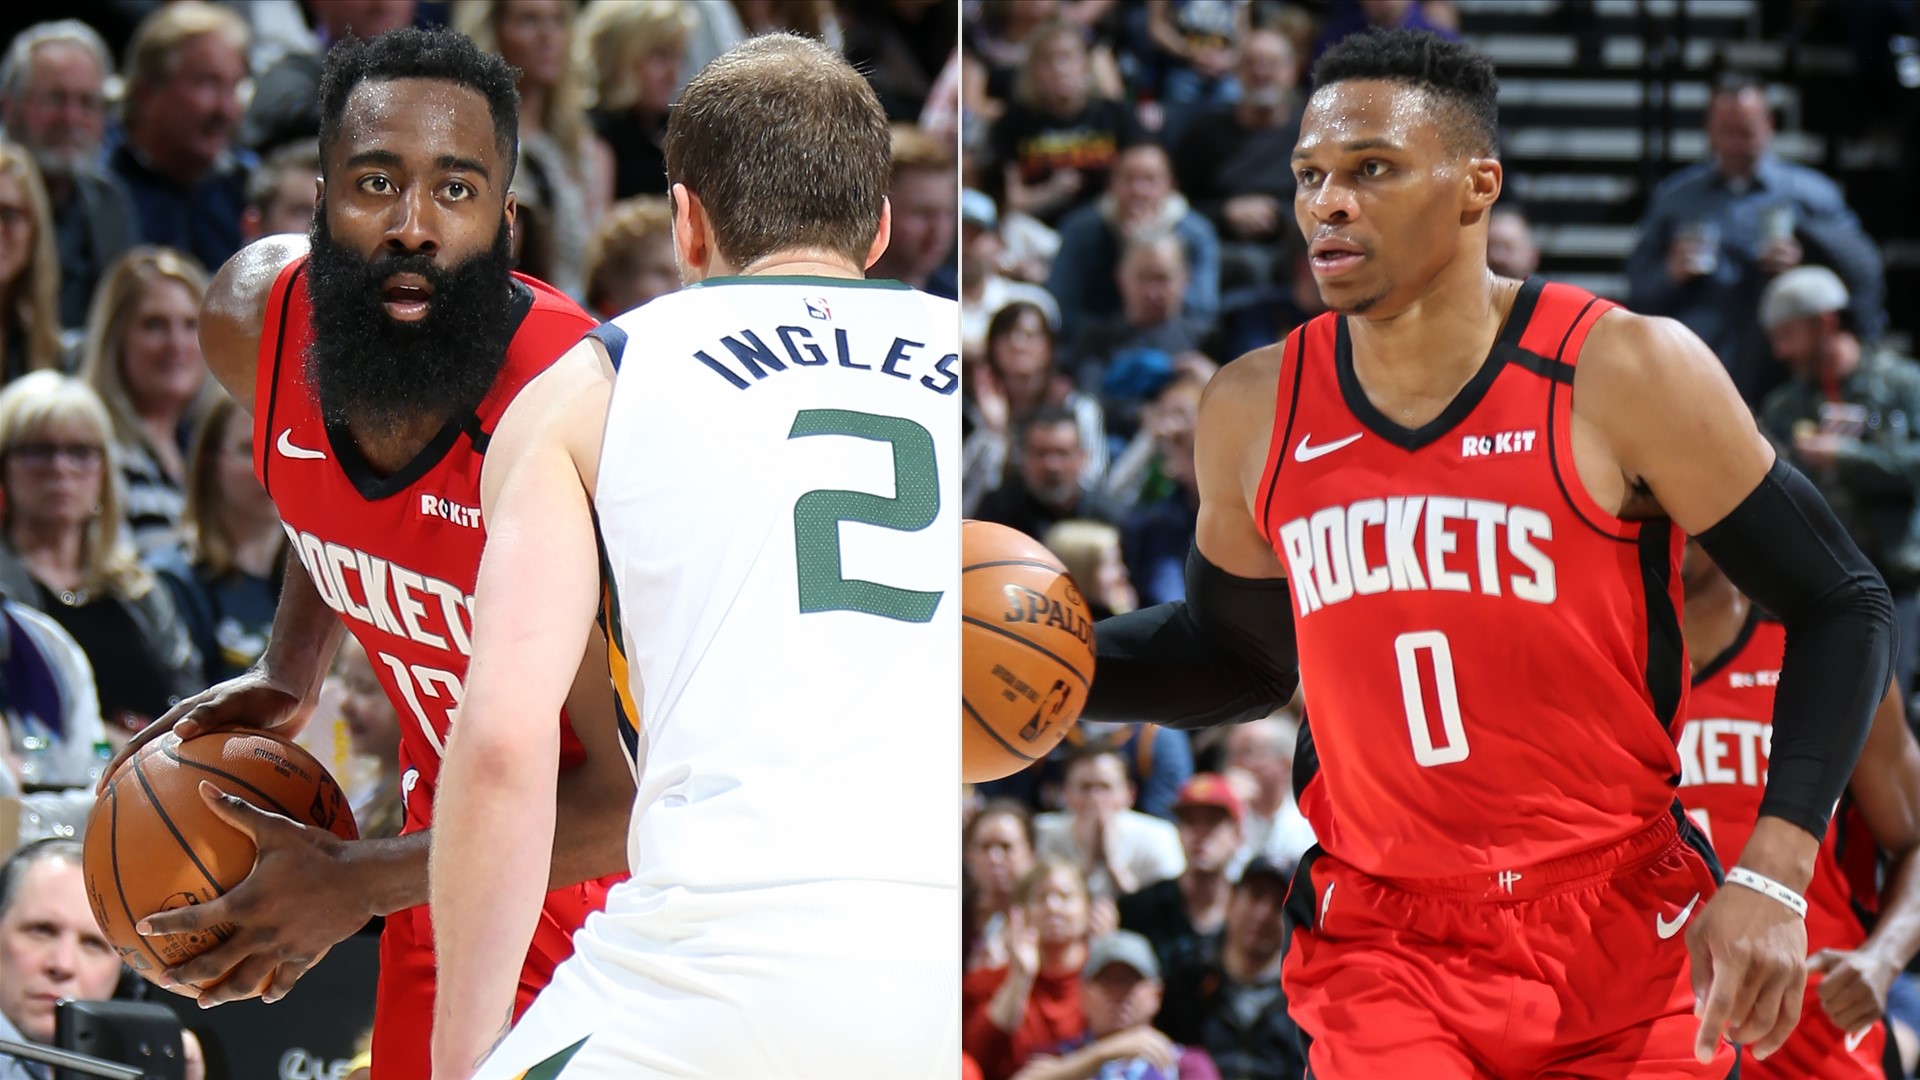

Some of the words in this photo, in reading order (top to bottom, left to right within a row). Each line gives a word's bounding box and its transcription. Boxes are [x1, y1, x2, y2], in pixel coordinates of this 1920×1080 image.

[692, 325, 958, 395] INGLES
[787, 409, 945, 623] 2
[1279, 495, 1557, 618] ROCKETS
[281, 519, 475, 657] OCKET
[1003, 583, 1095, 654] SPALD
[1395, 629, 1470, 767] 0
